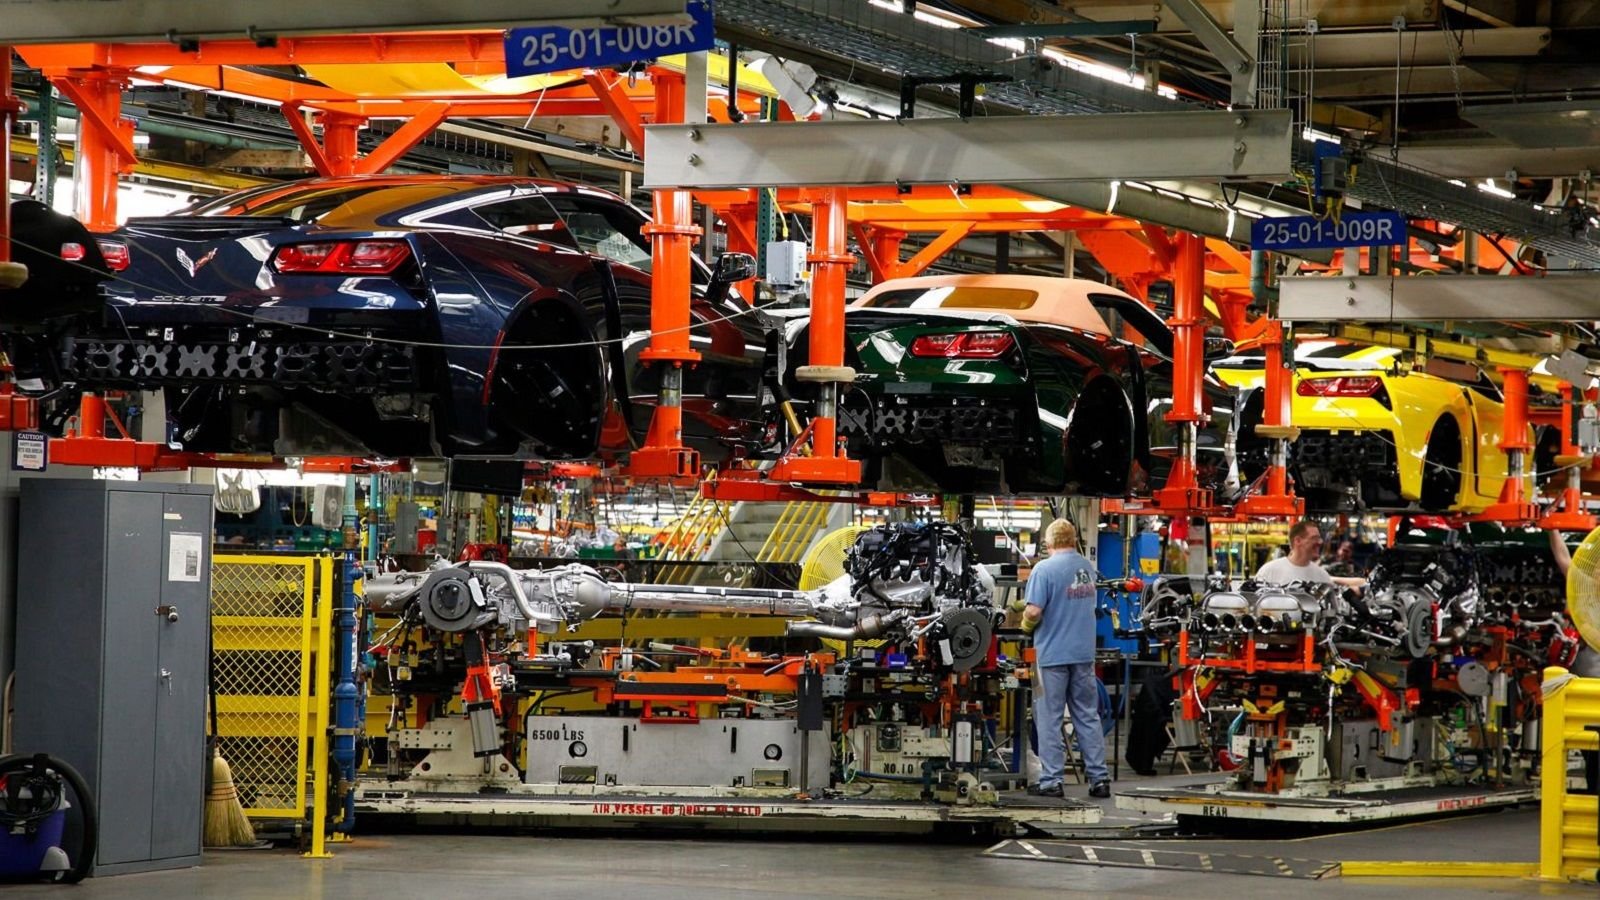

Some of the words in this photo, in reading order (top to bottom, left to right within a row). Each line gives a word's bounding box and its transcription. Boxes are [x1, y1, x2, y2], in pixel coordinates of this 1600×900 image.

[522, 26, 695, 67] 25-01-008R
[1264, 219, 1393, 244] 25-01-009R
[18, 433, 44, 441] CAUTION
[532, 729, 560, 741] 6500
[563, 729, 585, 741] LBS
[592, 803, 610, 814] AIR
[1203, 805, 1228, 817] REAR
